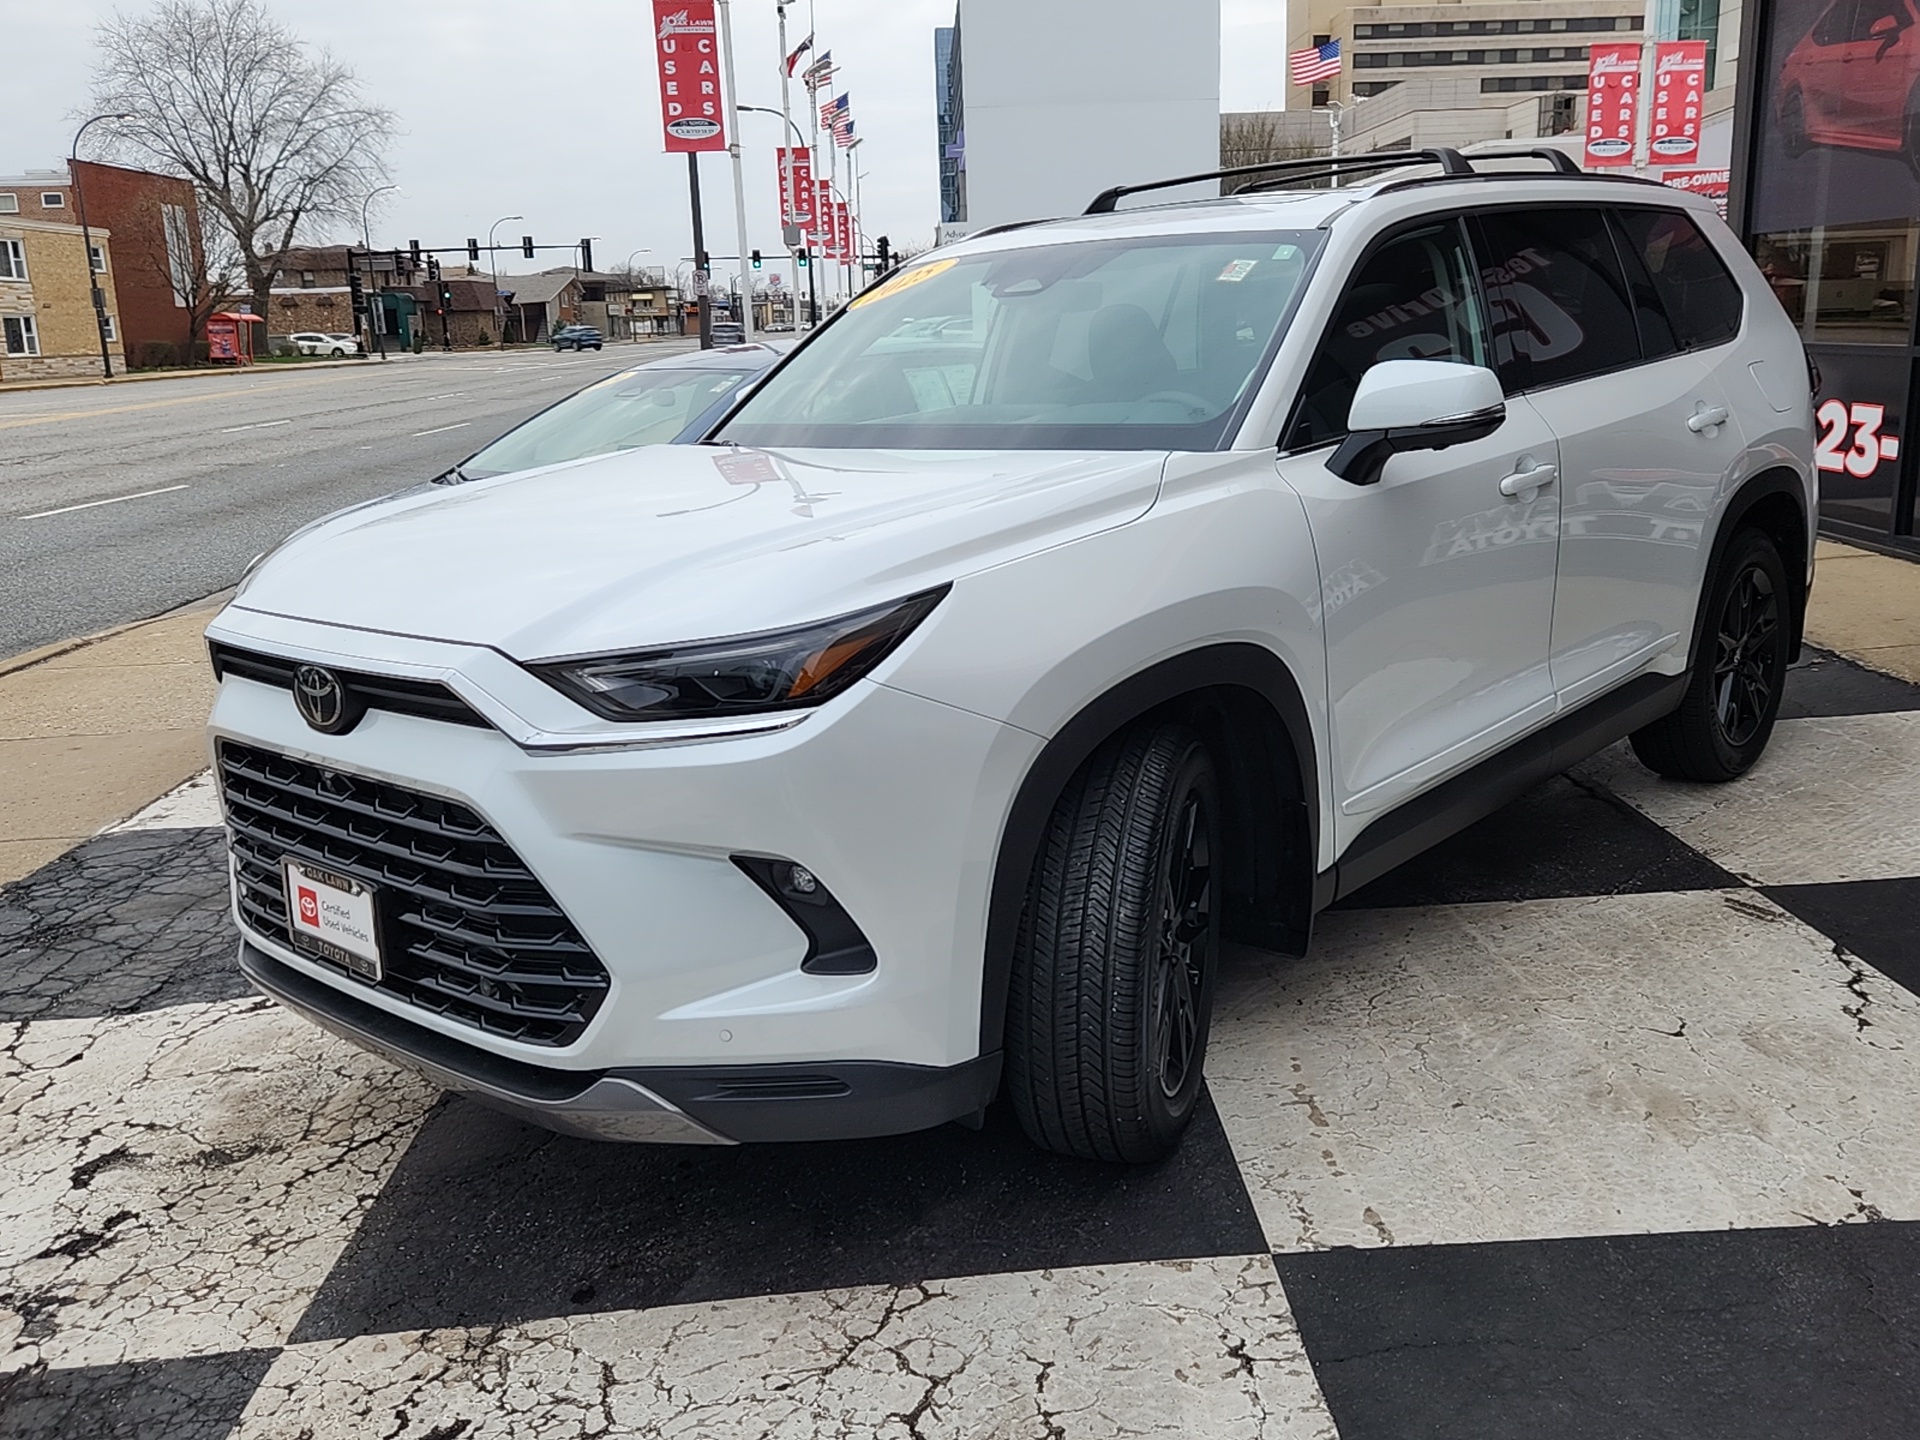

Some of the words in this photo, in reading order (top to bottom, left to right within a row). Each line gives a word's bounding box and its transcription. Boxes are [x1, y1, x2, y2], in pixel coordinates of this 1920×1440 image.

[662, 39, 682, 116] USED
[697, 39, 715, 116] CARS
[1590, 76, 1606, 138] USED
[1617, 75, 1634, 138] CARS
[1655, 74, 1671, 136] USED
[1683, 73, 1699, 136] CARS
[800, 168, 810, 211] CARS
[307, 867, 324, 882] OAK
[324, 872, 350, 891] LAWN
[321, 900, 351, 919] Certified
[317, 940, 352, 965] TOYOTA
[322, 915, 340, 931] Used
[341, 922, 369, 942] Vehicles
